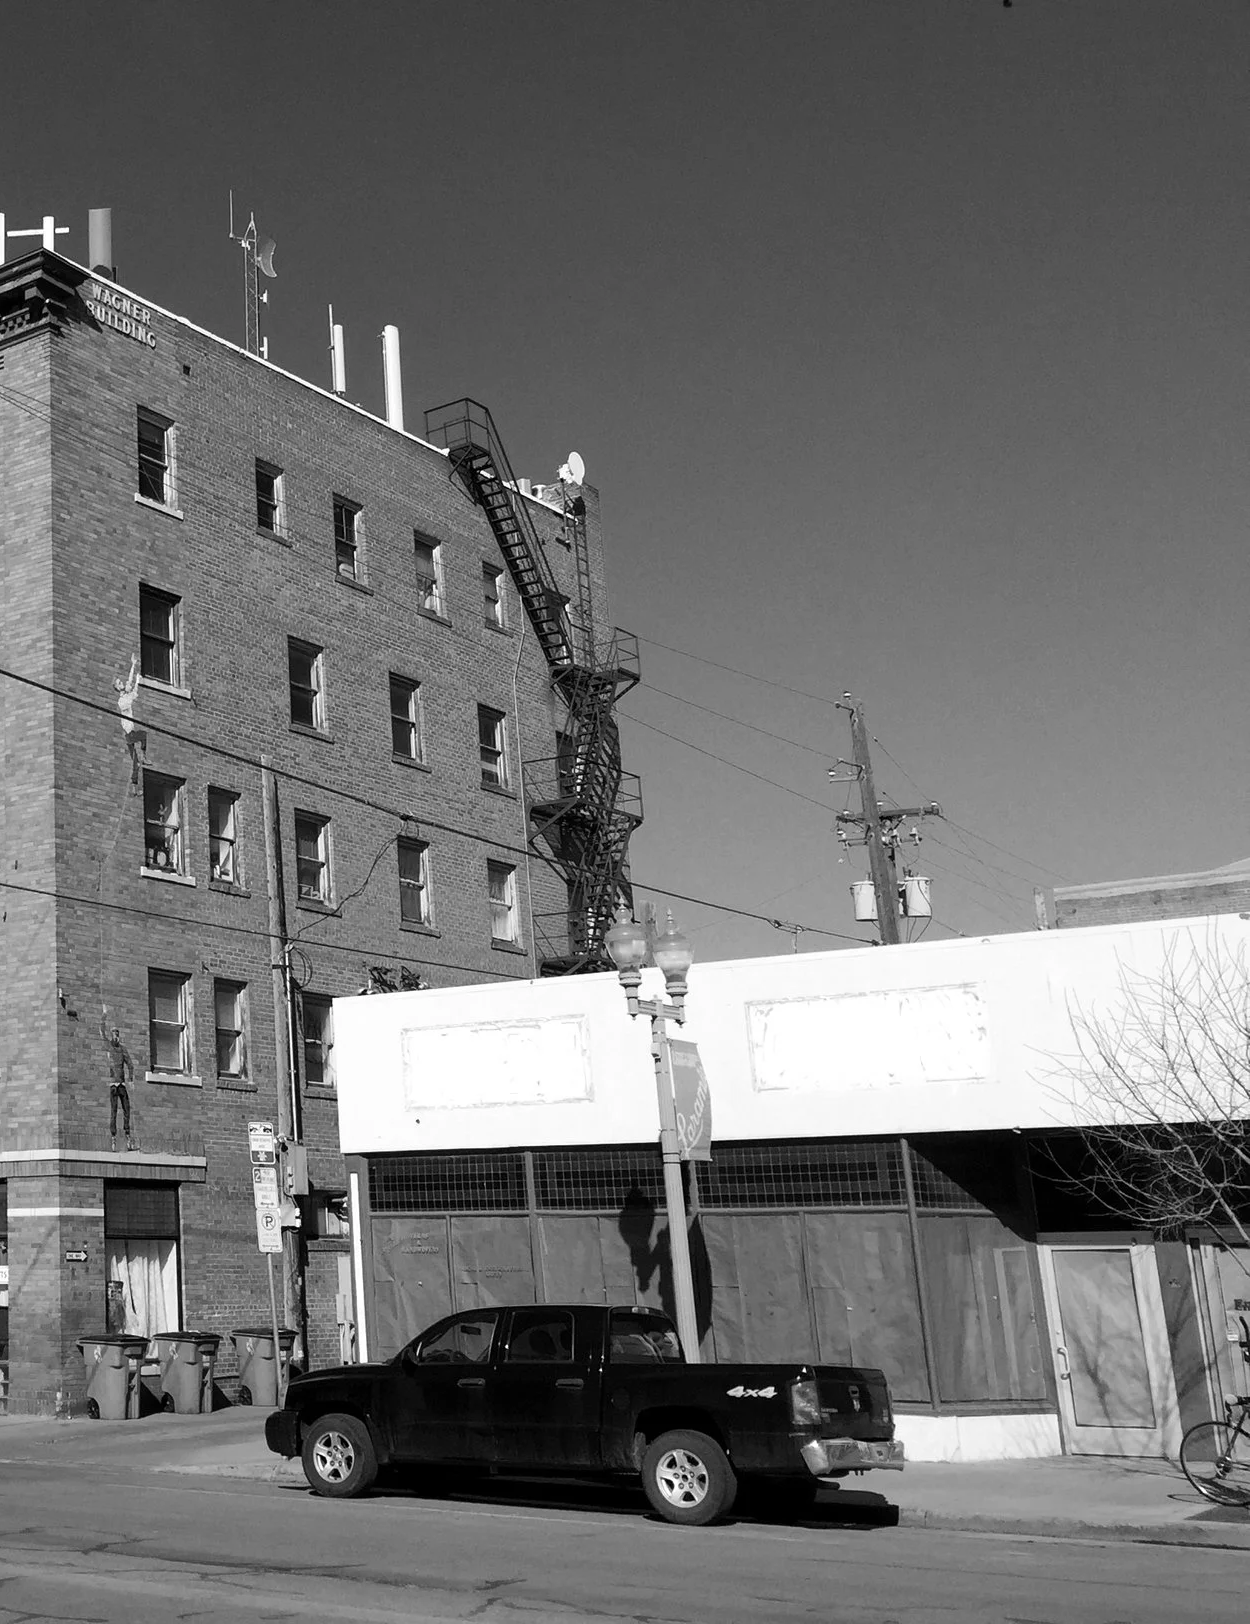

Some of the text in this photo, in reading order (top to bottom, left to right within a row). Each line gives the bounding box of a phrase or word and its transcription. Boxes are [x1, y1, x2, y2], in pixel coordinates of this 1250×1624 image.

[86, 300, 156, 348] BUILDING
[92, 283, 151, 326] WAGNER
[727, 1386, 778, 1399] 4x4
